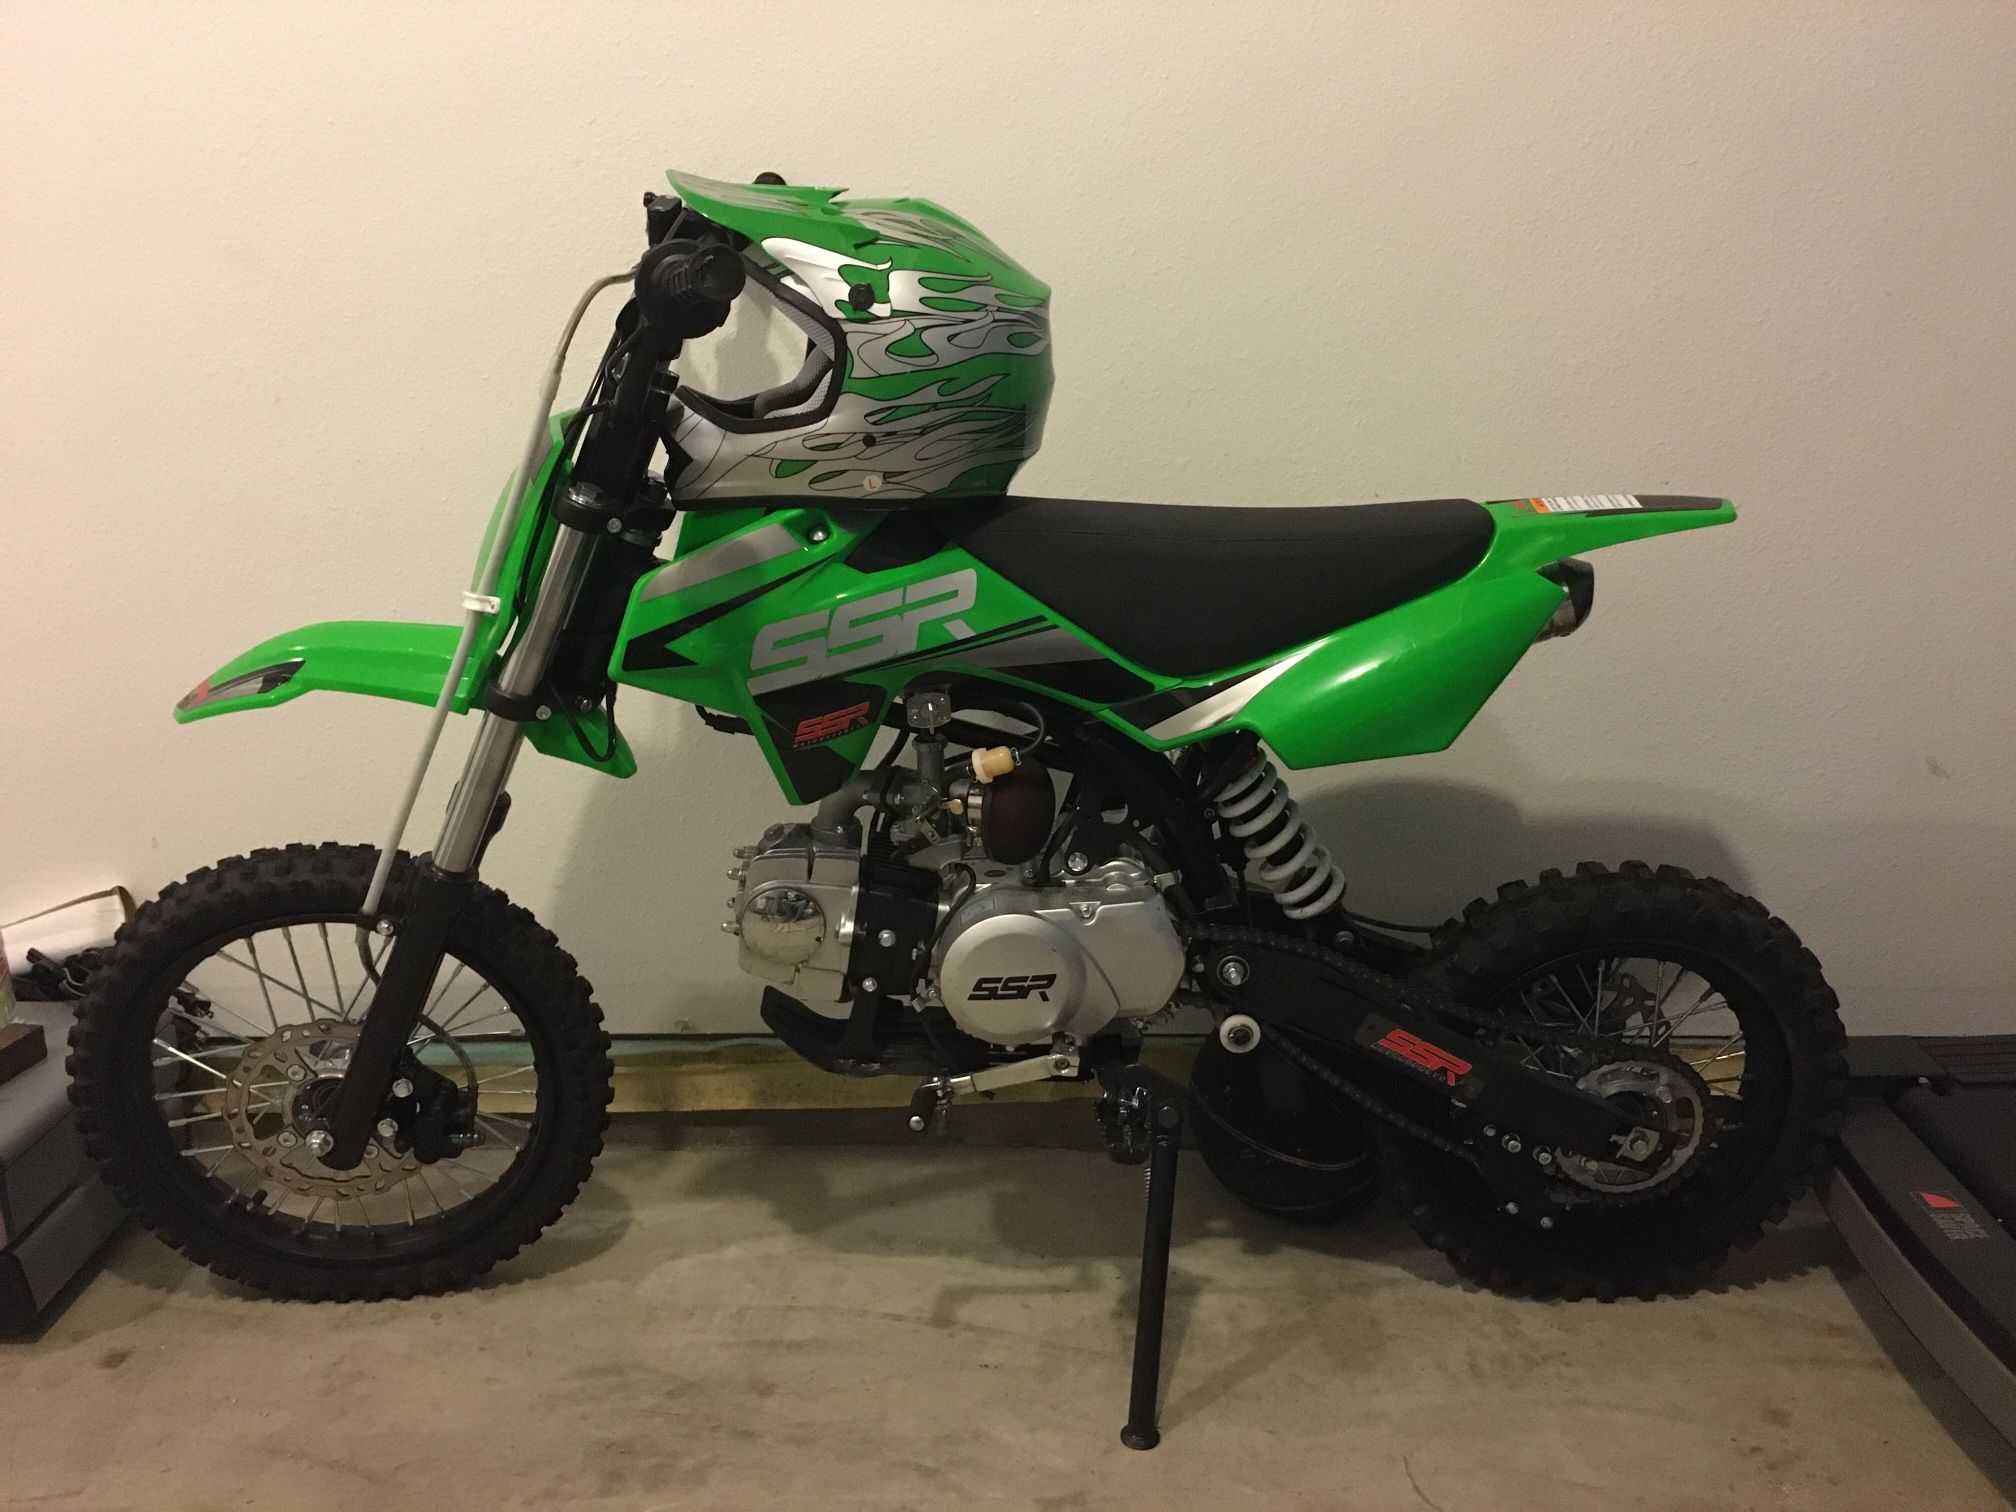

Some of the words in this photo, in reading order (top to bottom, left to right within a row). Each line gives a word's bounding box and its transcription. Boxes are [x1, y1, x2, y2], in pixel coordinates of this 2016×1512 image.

[868, 478, 877, 490] L
[747, 568, 977, 696] SSR
[794, 701, 870, 744] SSR
[967, 973, 1057, 1002] SSR
[1377, 1028, 1473, 1086] SSR
